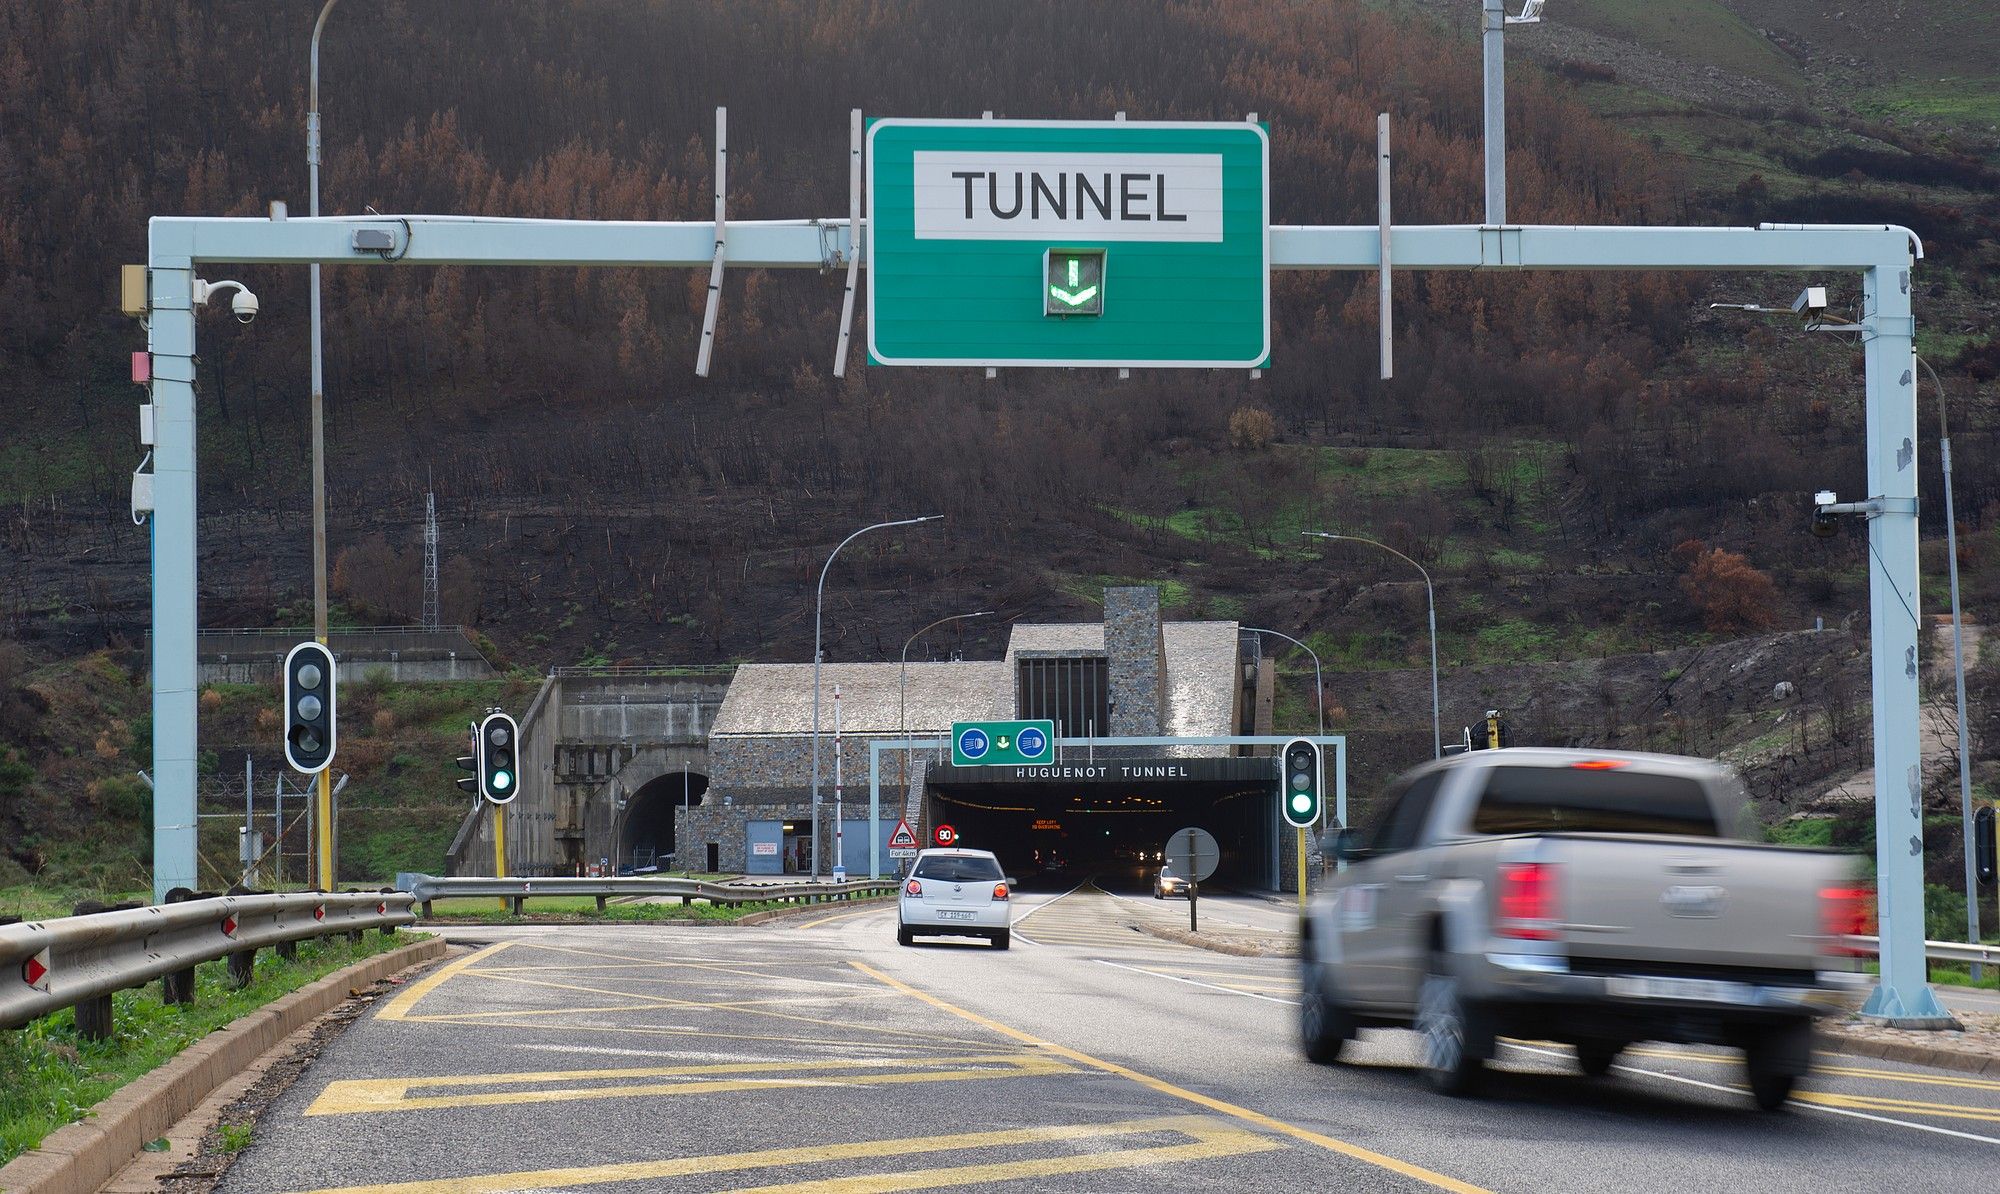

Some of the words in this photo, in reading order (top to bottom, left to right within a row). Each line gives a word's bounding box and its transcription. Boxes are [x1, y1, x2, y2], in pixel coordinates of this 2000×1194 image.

[952, 171, 1187, 222] TUNNEL
[1016, 767, 1107, 778] HUGUENOT
[1122, 766, 1188, 777] TUNNEL
[939, 830, 951, 840] 90
